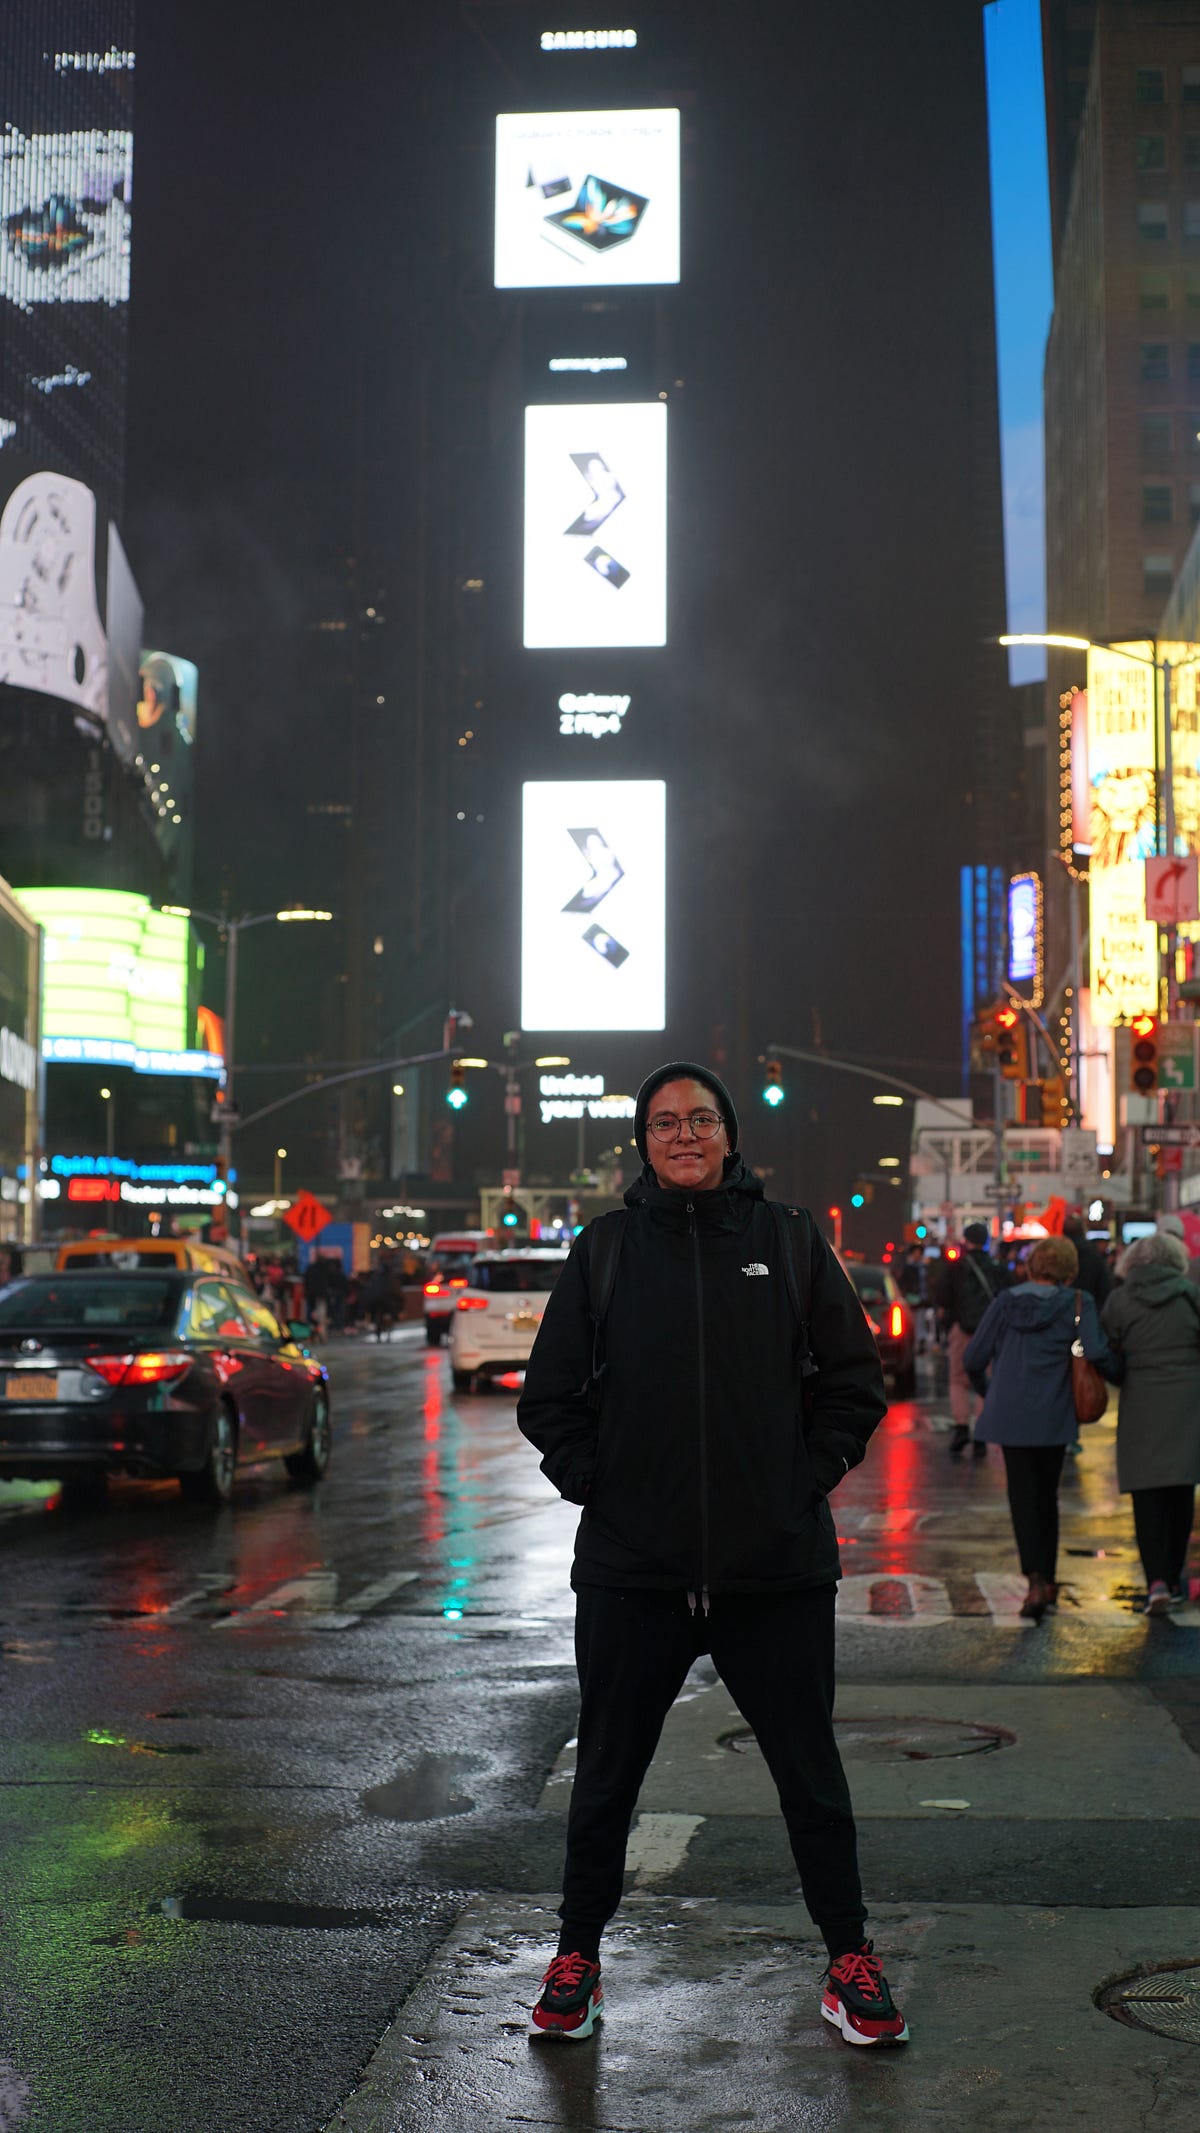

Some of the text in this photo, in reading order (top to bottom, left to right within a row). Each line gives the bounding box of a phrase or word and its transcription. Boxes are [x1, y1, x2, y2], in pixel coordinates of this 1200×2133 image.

[541, 29, 637, 50] SAMSUNG
[540, 1073, 604, 1096] Unfold
[540, 1099, 584, 1124] your
